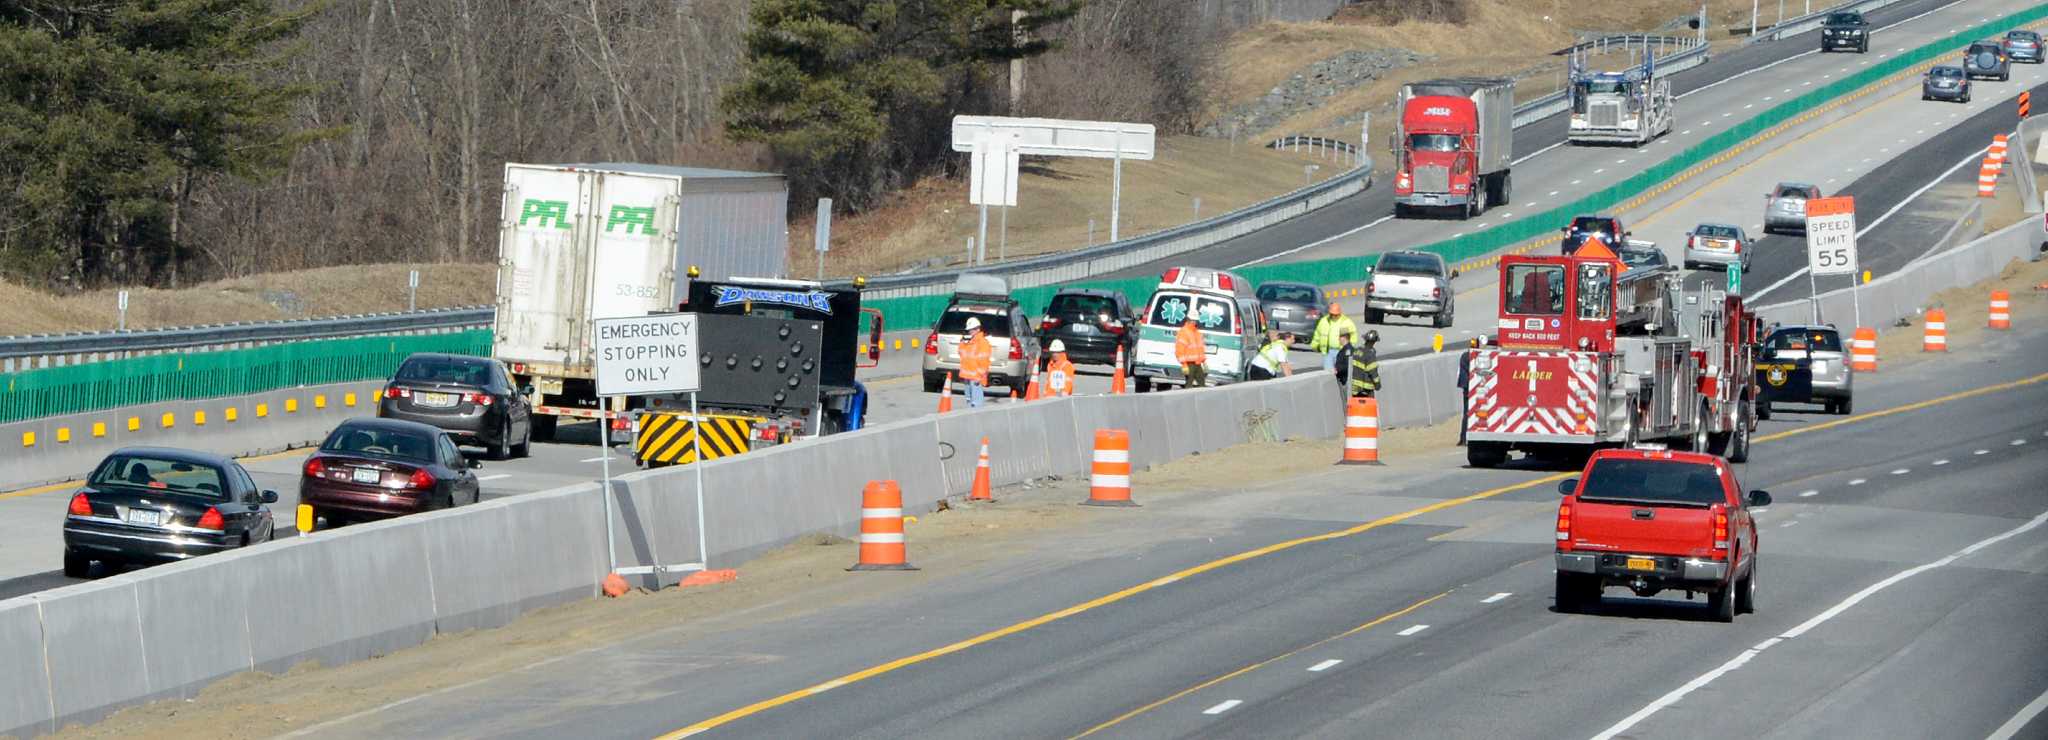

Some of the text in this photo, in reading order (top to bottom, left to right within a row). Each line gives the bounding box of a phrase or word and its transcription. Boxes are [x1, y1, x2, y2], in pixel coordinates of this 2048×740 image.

[519, 199, 573, 230] PFL
[605, 204, 660, 235] PFL
[1811, 220, 1850, 232] SPEED
[1816, 234, 1847, 246] LIMIT
[1818, 248, 1848, 267] 55
[601, 321, 690, 339] EMERGENCY
[604, 344, 687, 360] STOPPING
[625, 366, 670, 382] ONLY
[1512, 369, 1553, 380] LADDER
